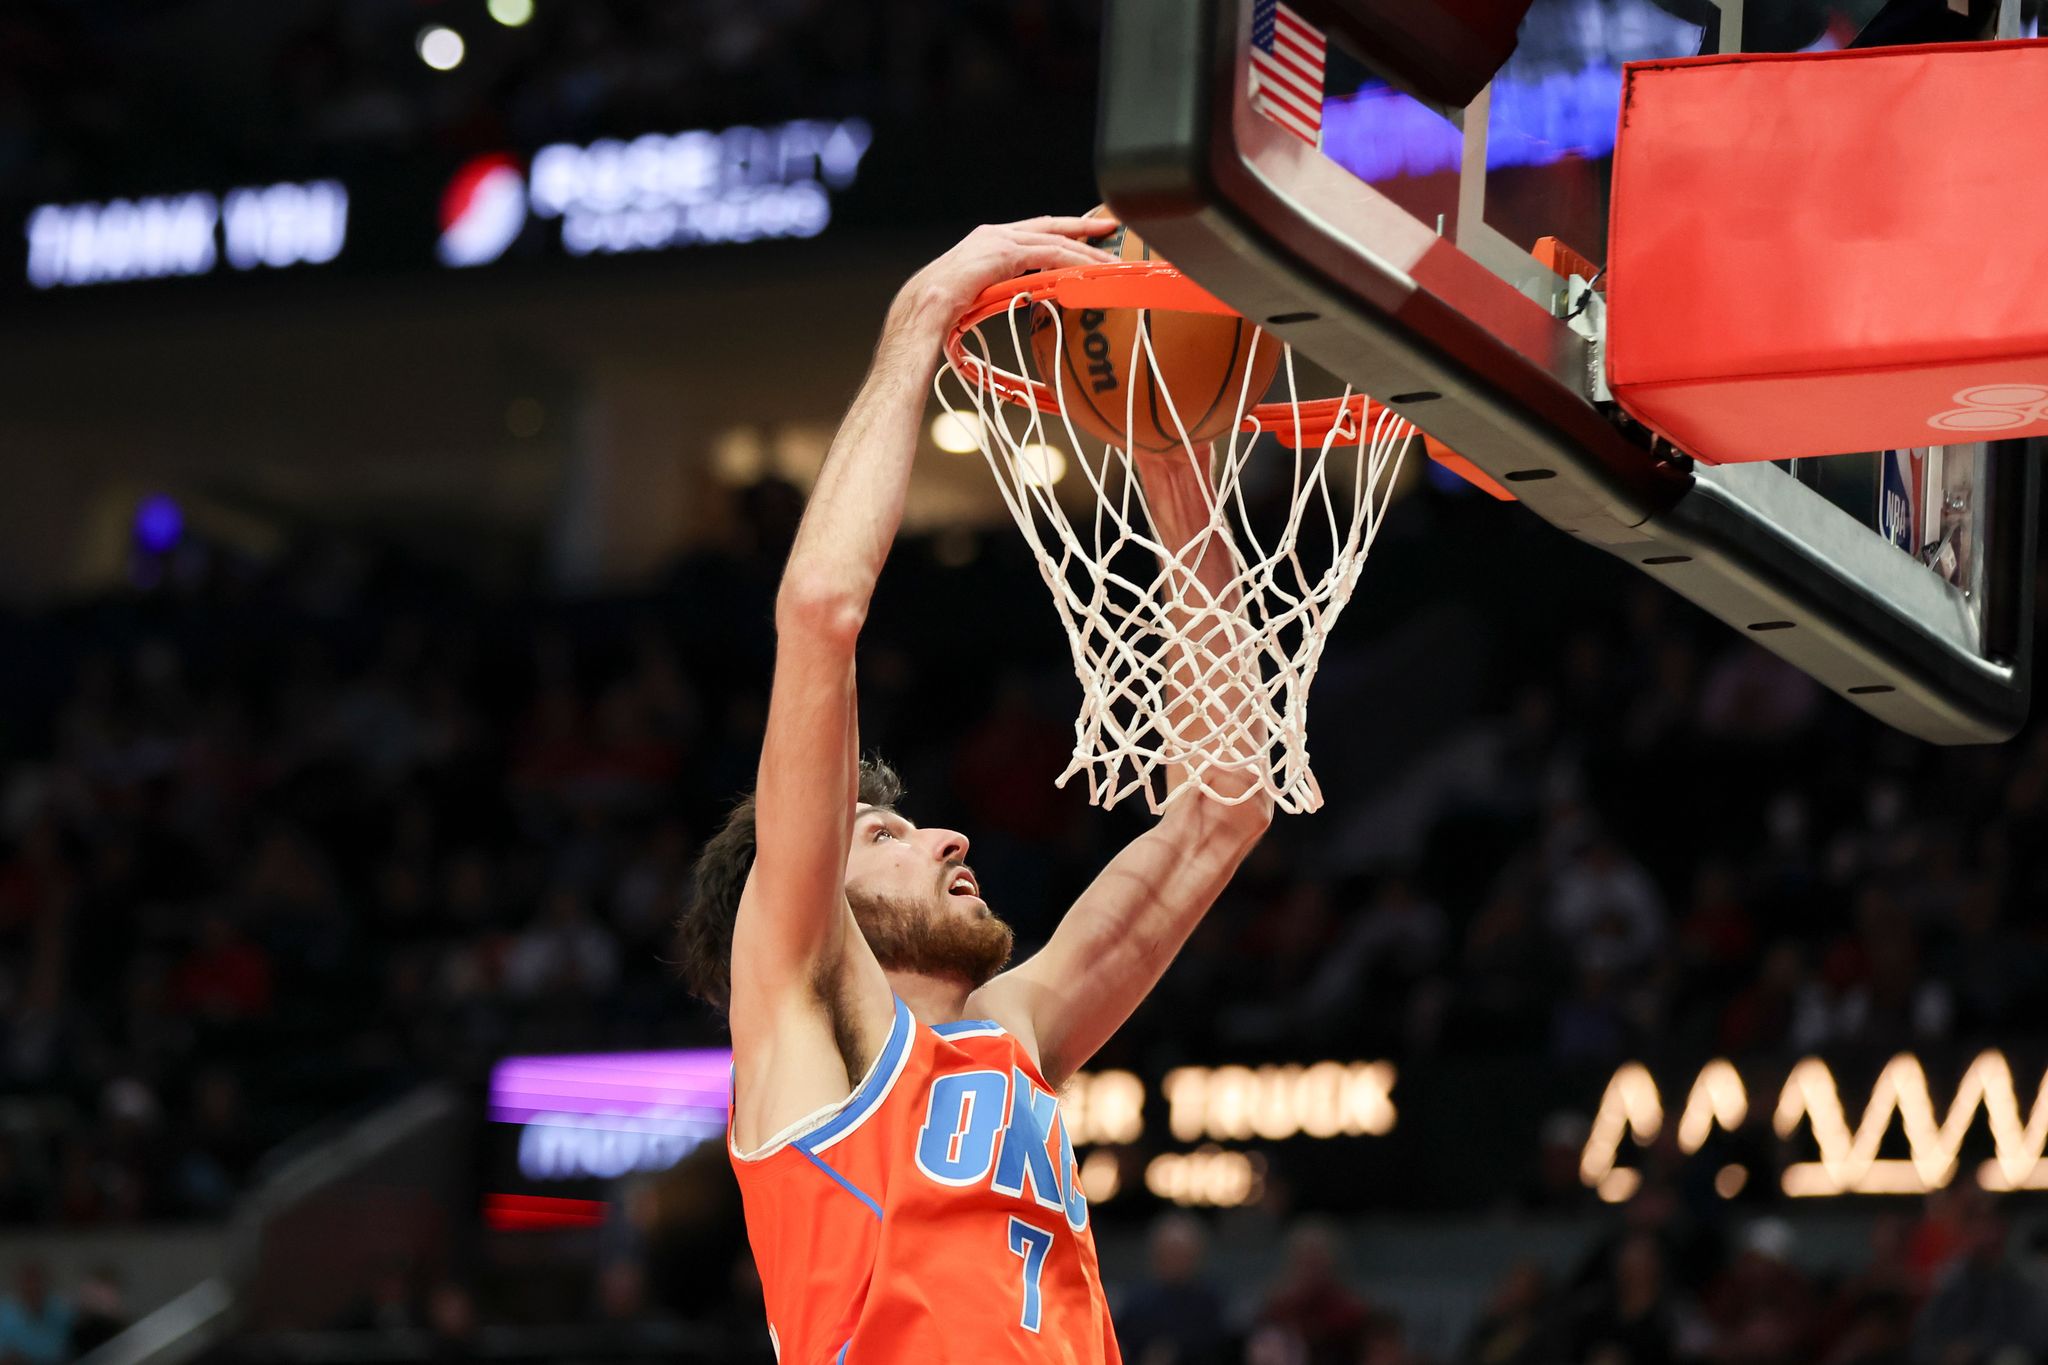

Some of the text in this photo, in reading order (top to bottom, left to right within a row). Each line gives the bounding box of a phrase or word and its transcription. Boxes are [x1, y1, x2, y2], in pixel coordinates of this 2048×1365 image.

[1886, 490, 1905, 538] NBA
[915, 1064, 1087, 1232] OKC
[1007, 1214, 1055, 1334] 7
